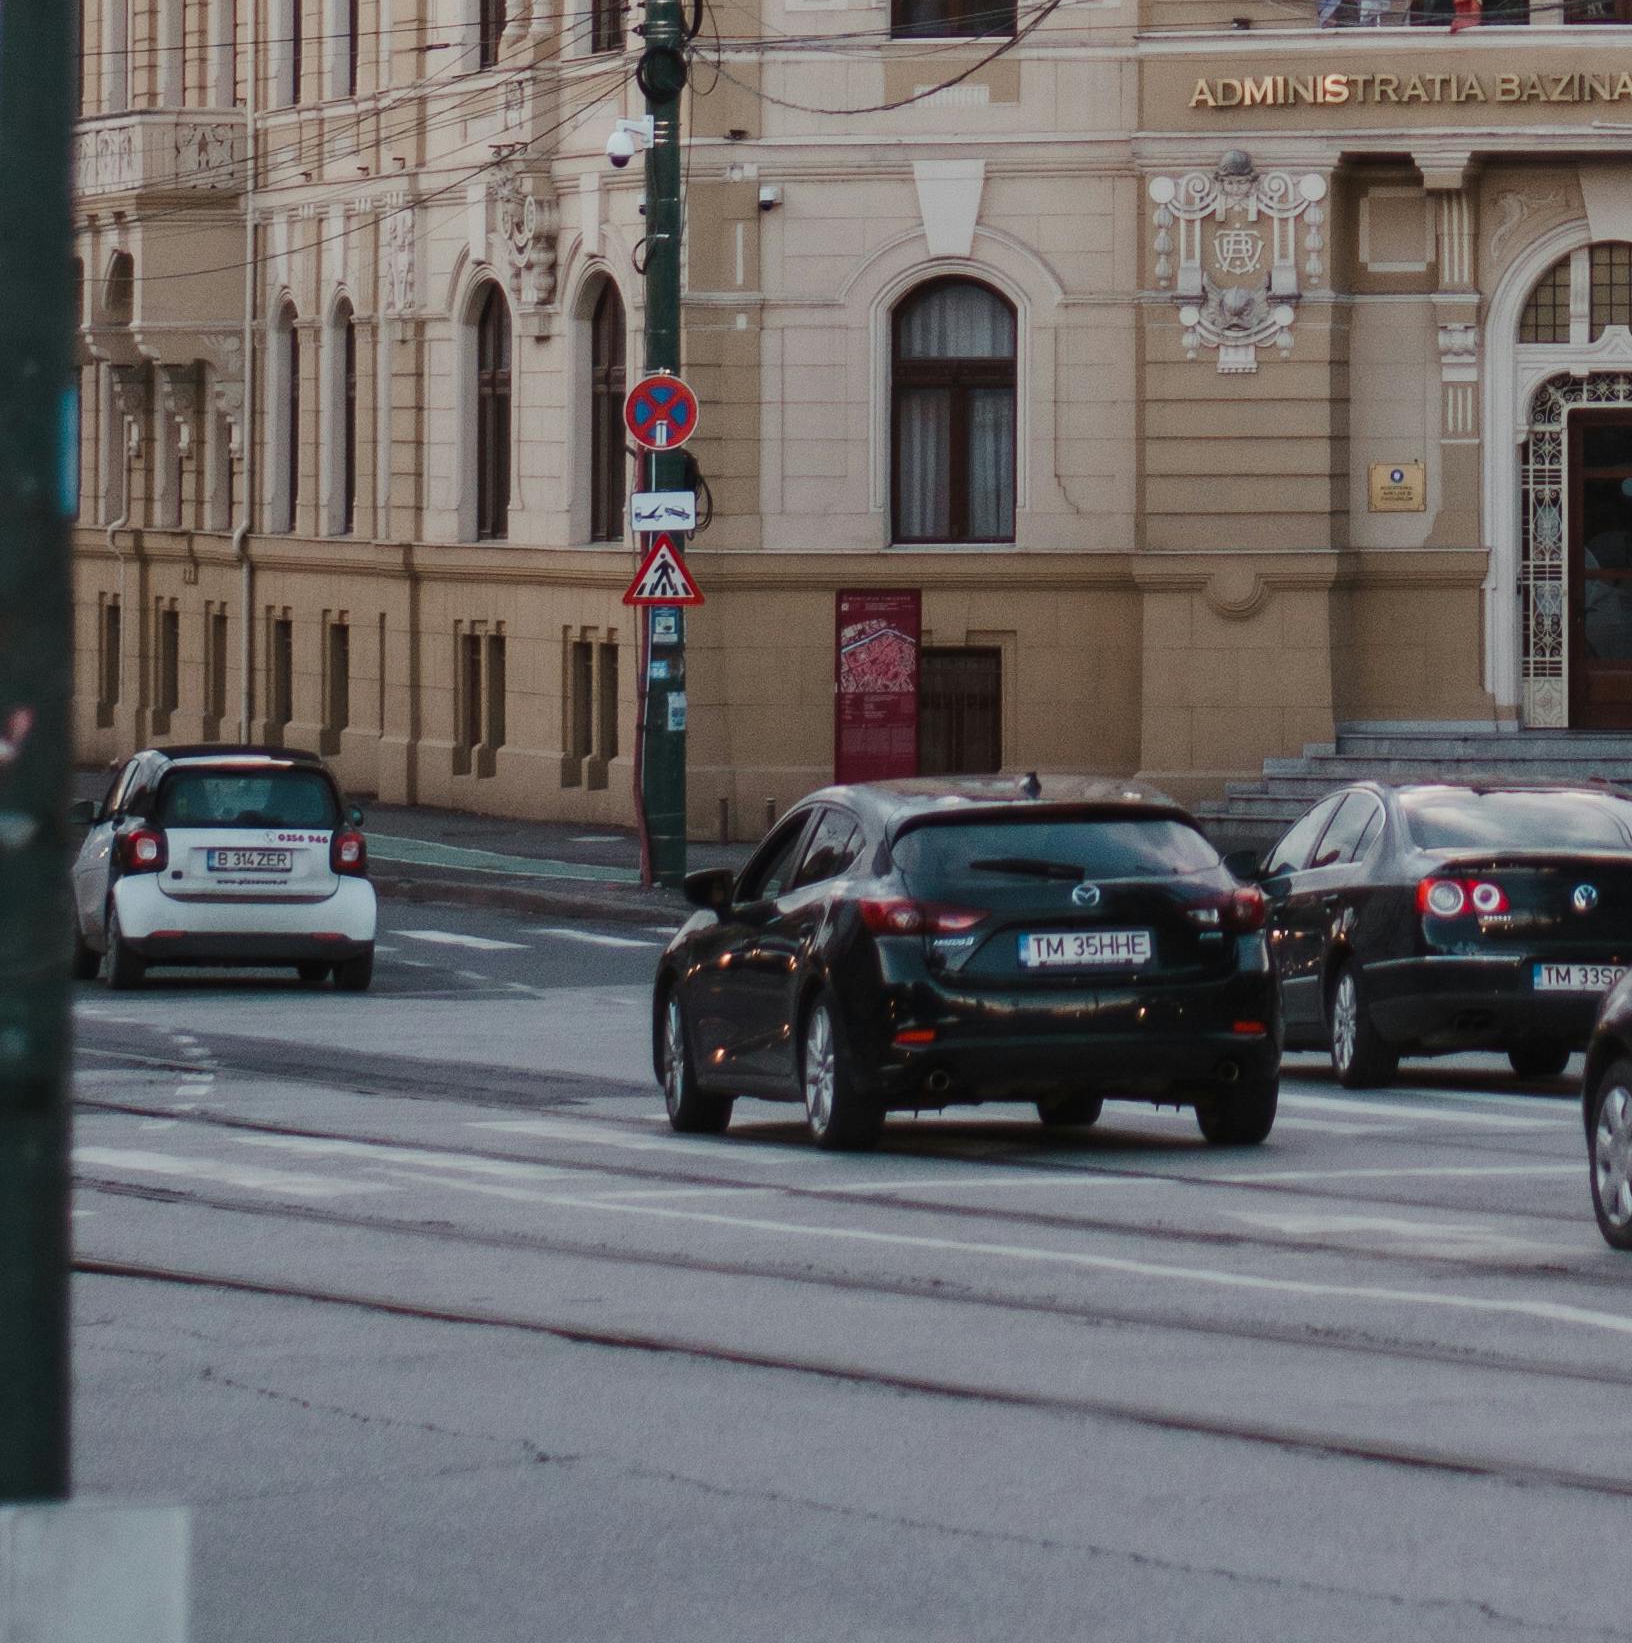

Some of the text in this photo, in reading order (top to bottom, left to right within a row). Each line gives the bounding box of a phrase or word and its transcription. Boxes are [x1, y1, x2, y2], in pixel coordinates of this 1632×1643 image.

[1188, 73, 1487, 108] ADMINISTRATIA
[218, 852, 228, 867] B
[1033, 934, 1147, 958] TM 35HHE
[1545, 966, 1571, 985] TM
